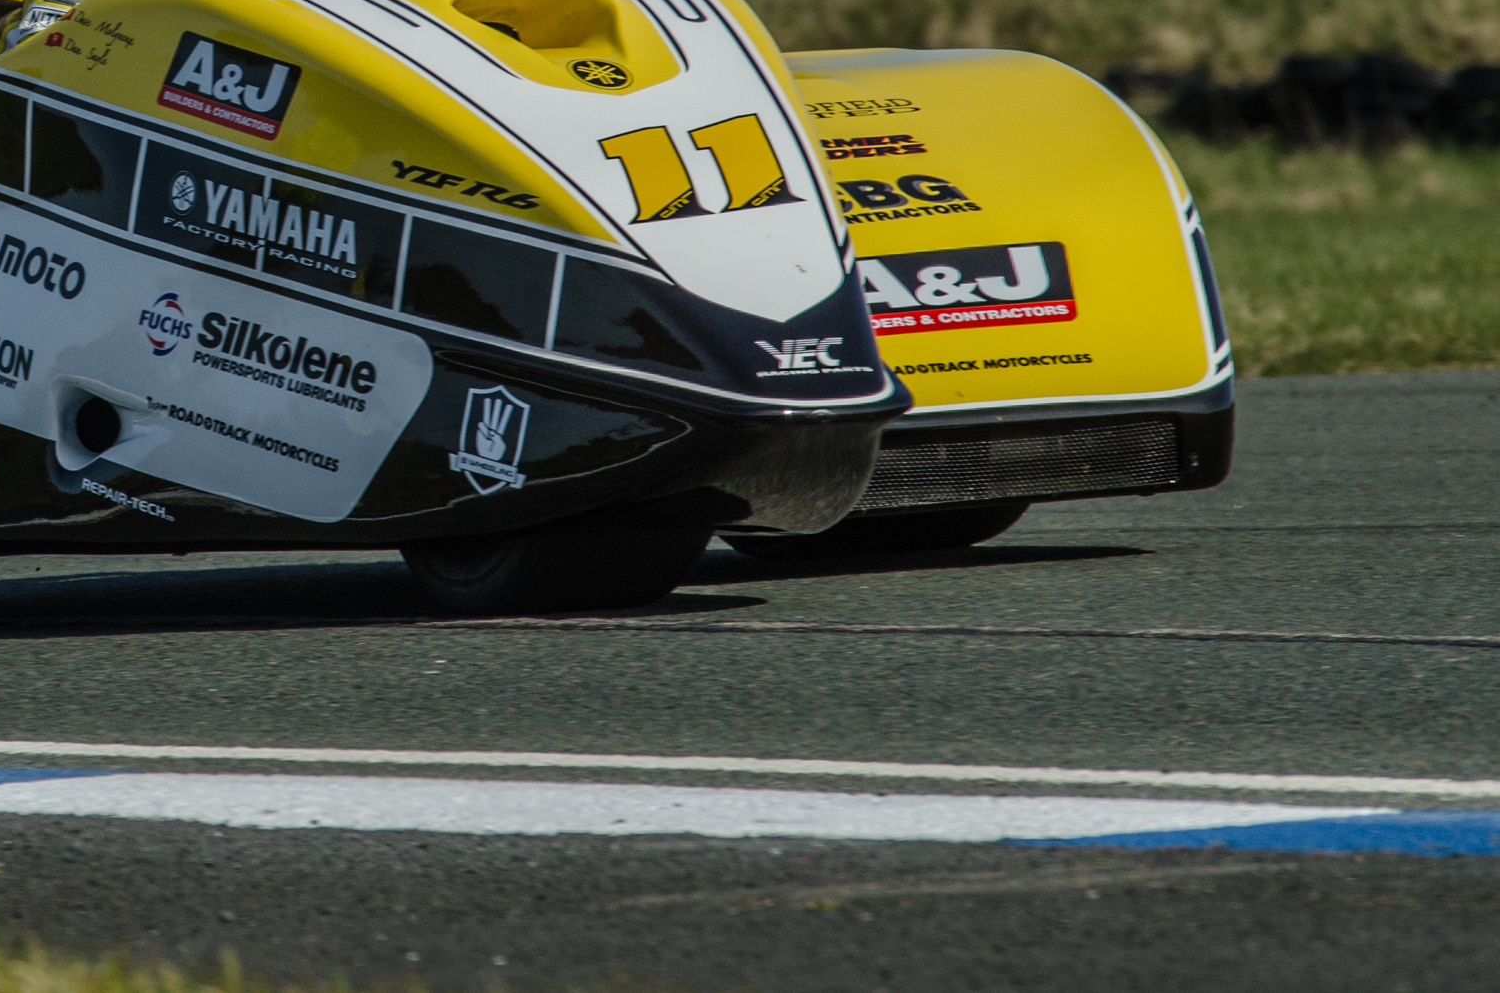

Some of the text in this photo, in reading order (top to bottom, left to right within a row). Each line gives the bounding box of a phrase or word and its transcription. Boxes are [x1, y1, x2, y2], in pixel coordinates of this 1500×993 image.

[171, 39, 290, 113] A&J
[162, 90, 276, 135] BUILDERS & CONTRACTORS
[391, 160, 467, 189] YZF
[597, 113, 808, 225] 11
[834, 174, 970, 213] BG
[204, 179, 358, 265] YAMAHA
[162, 216, 358, 279] FACTORY RACING
[855, 245, 1050, 309] A&J
[138, 308, 193, 340] FUCHS
[920, 315, 936, 325] &
[938, 304, 1070, 323] CONTRACTORS
[198, 312, 376, 394] Silkolene
[983, 353, 1094, 370] MOTORCYCLES
[192, 351, 367, 412] POWERSPORTS LUBRICANTS
[252, 433, 339, 473] MOTORCYCLES
[81, 478, 167, 521] REPAIR-TECH
